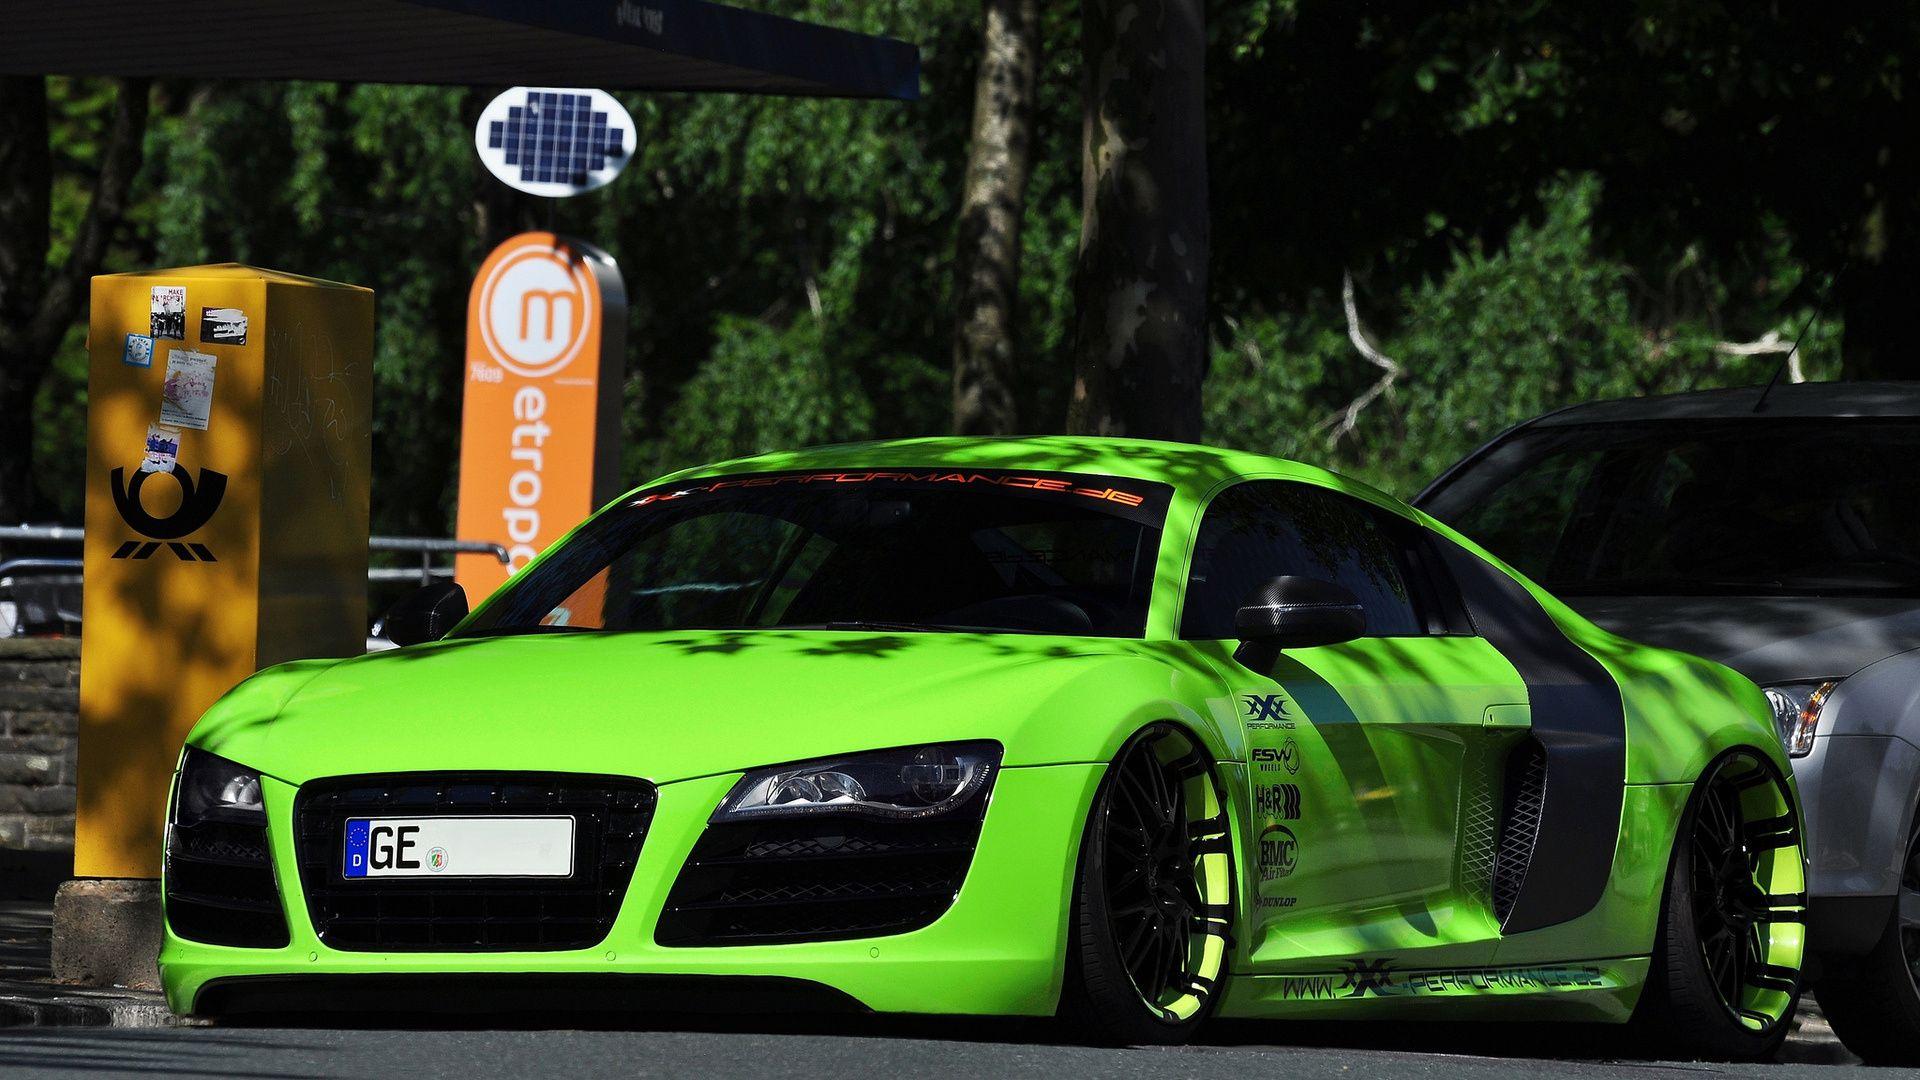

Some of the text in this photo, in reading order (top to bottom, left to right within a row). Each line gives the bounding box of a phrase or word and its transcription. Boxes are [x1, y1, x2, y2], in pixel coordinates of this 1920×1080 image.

[1252, 748, 1292, 762] FSW
[1255, 784, 1282, 814] H&R
[369, 826, 420, 869] GE
[1260, 840, 1294, 866] BMC
[352, 854, 362, 867] D
[1262, 897, 1297, 907] DUNLOP
